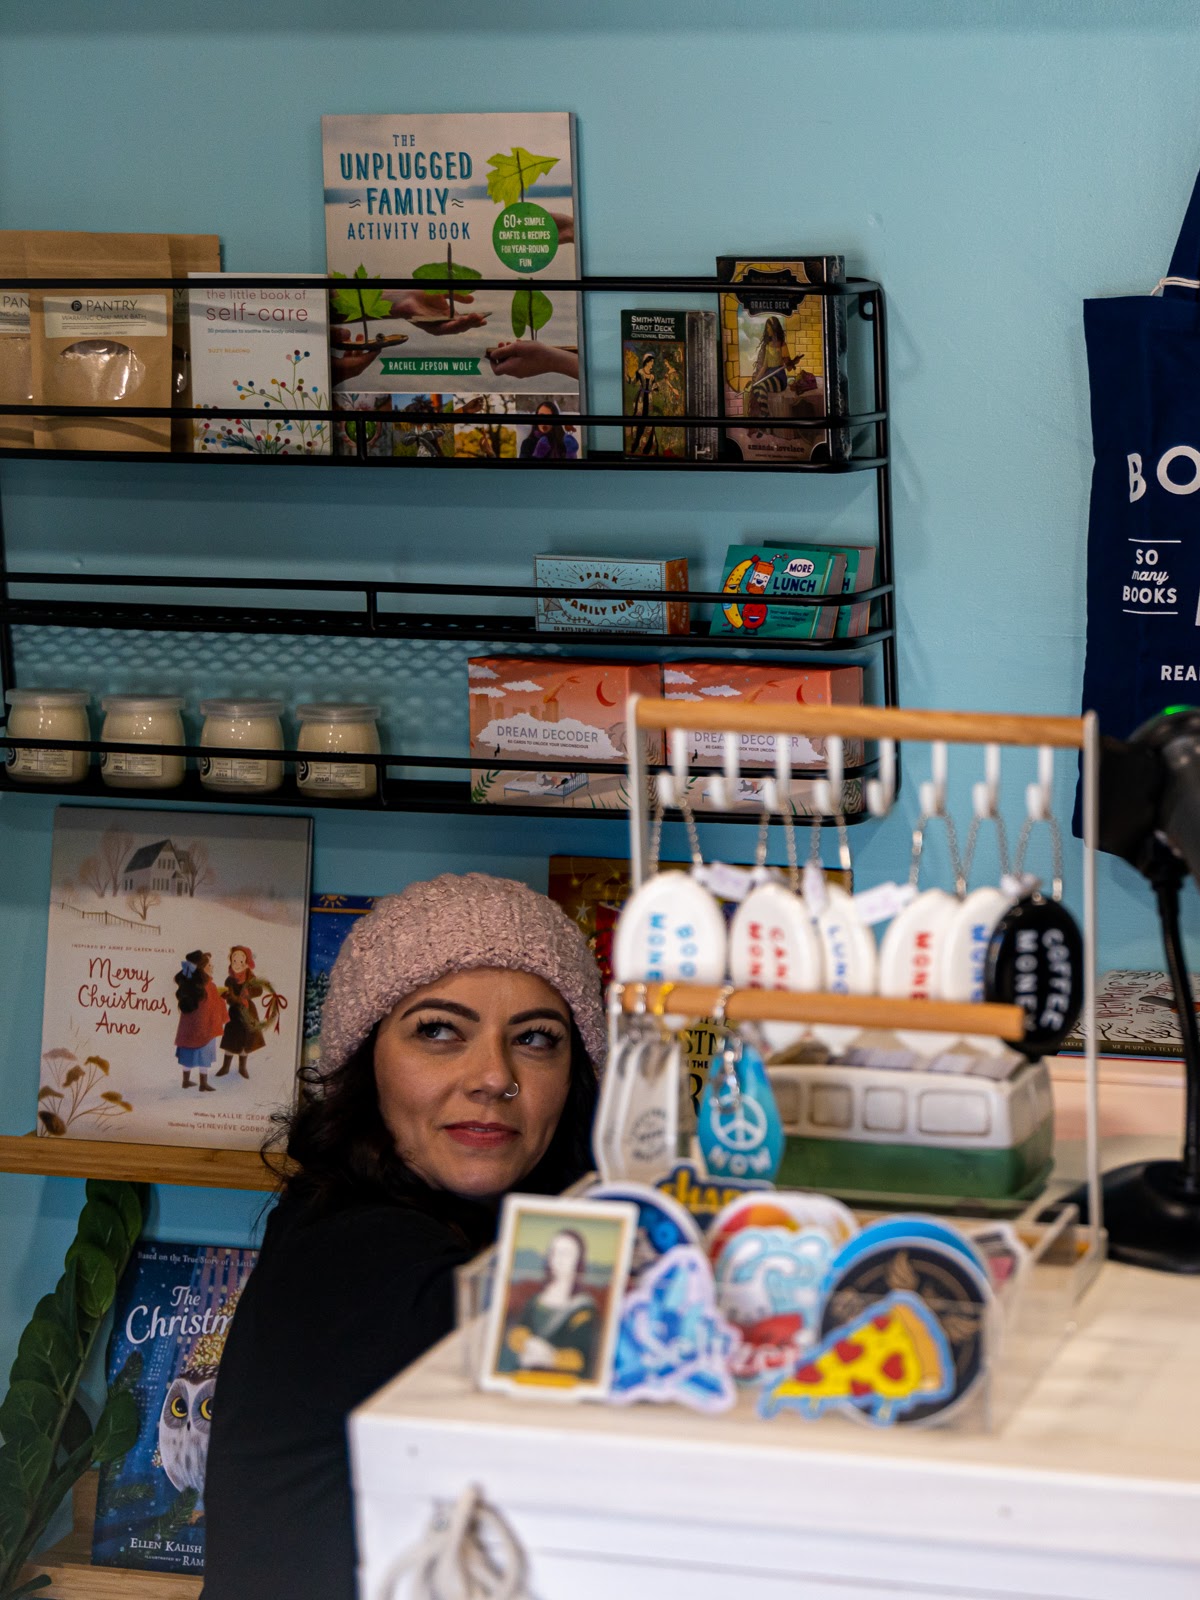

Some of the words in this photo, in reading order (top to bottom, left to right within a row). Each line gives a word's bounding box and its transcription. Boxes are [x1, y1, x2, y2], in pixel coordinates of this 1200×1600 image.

[393, 134, 415, 147] THE
[340, 151, 473, 180] UNPLUGGED
[366, 187, 450, 216] FAMILY
[503, 214, 522, 228] 60+
[524, 217, 545, 226] SIMPLE
[347, 222, 419, 240] ACTIVITY
[428, 222, 471, 240] BOOK
[499, 230, 520, 240] CRAFTS
[527, 230, 551, 240] RECIPES
[511, 244, 550, 254] YEAR-ROUND
[519, 258, 532, 267] FUN
[206, 289, 226, 300] the
[230, 289, 257, 300] little
[260, 289, 290, 300] book
[294, 289, 307, 300] of
[86, 299, 138, 312] PANTRY
[206, 302, 308, 321] self-care
[750, 301, 773, 310] ORACLE
[774, 301, 790, 310] DECK
[388, 360, 417, 371] RACHEL
[420, 360, 449, 371] JEPSON
[452, 360, 473, 371] WOLF
[1135, 548, 1159, 566] SO
[789, 563, 813, 573] MORE
[579, 571, 619, 584] SPARK
[773, 577, 817, 593] LUNCH
[1131, 570, 1170, 586] many
[1122, 585, 1178, 604] BOOKS
[611, 599, 635, 614] FUN
[496, 725, 538, 739] DREAM
[542, 728, 599, 743] DECODER
[694, 731, 725, 743] DREA
[741, 734, 799, 748] DECOR
[645, 913, 666, 981] MONE
[89, 957, 155, 993] Merry
[1041, 928, 1073, 1032] COFFEE
[78, 984, 171, 1016] Christmas,
[95, 1010, 141, 1035] Anne
[692, 1060, 708, 1069] THE
[217, 1112, 242, 1120] KALLIE
[138, 1252, 157, 1260] Based
[169, 1254, 181, 1264] the
[182, 1255, 199, 1264] True
[220, 1258, 229, 1266] of
[170, 1285, 201, 1307] The
[126, 1304, 234, 1345] Christm
[130, 1537, 162, 1549] ELLEN
[165, 1541, 202, 1554] KALISH
[182, 1555, 205, 1567] RAM
